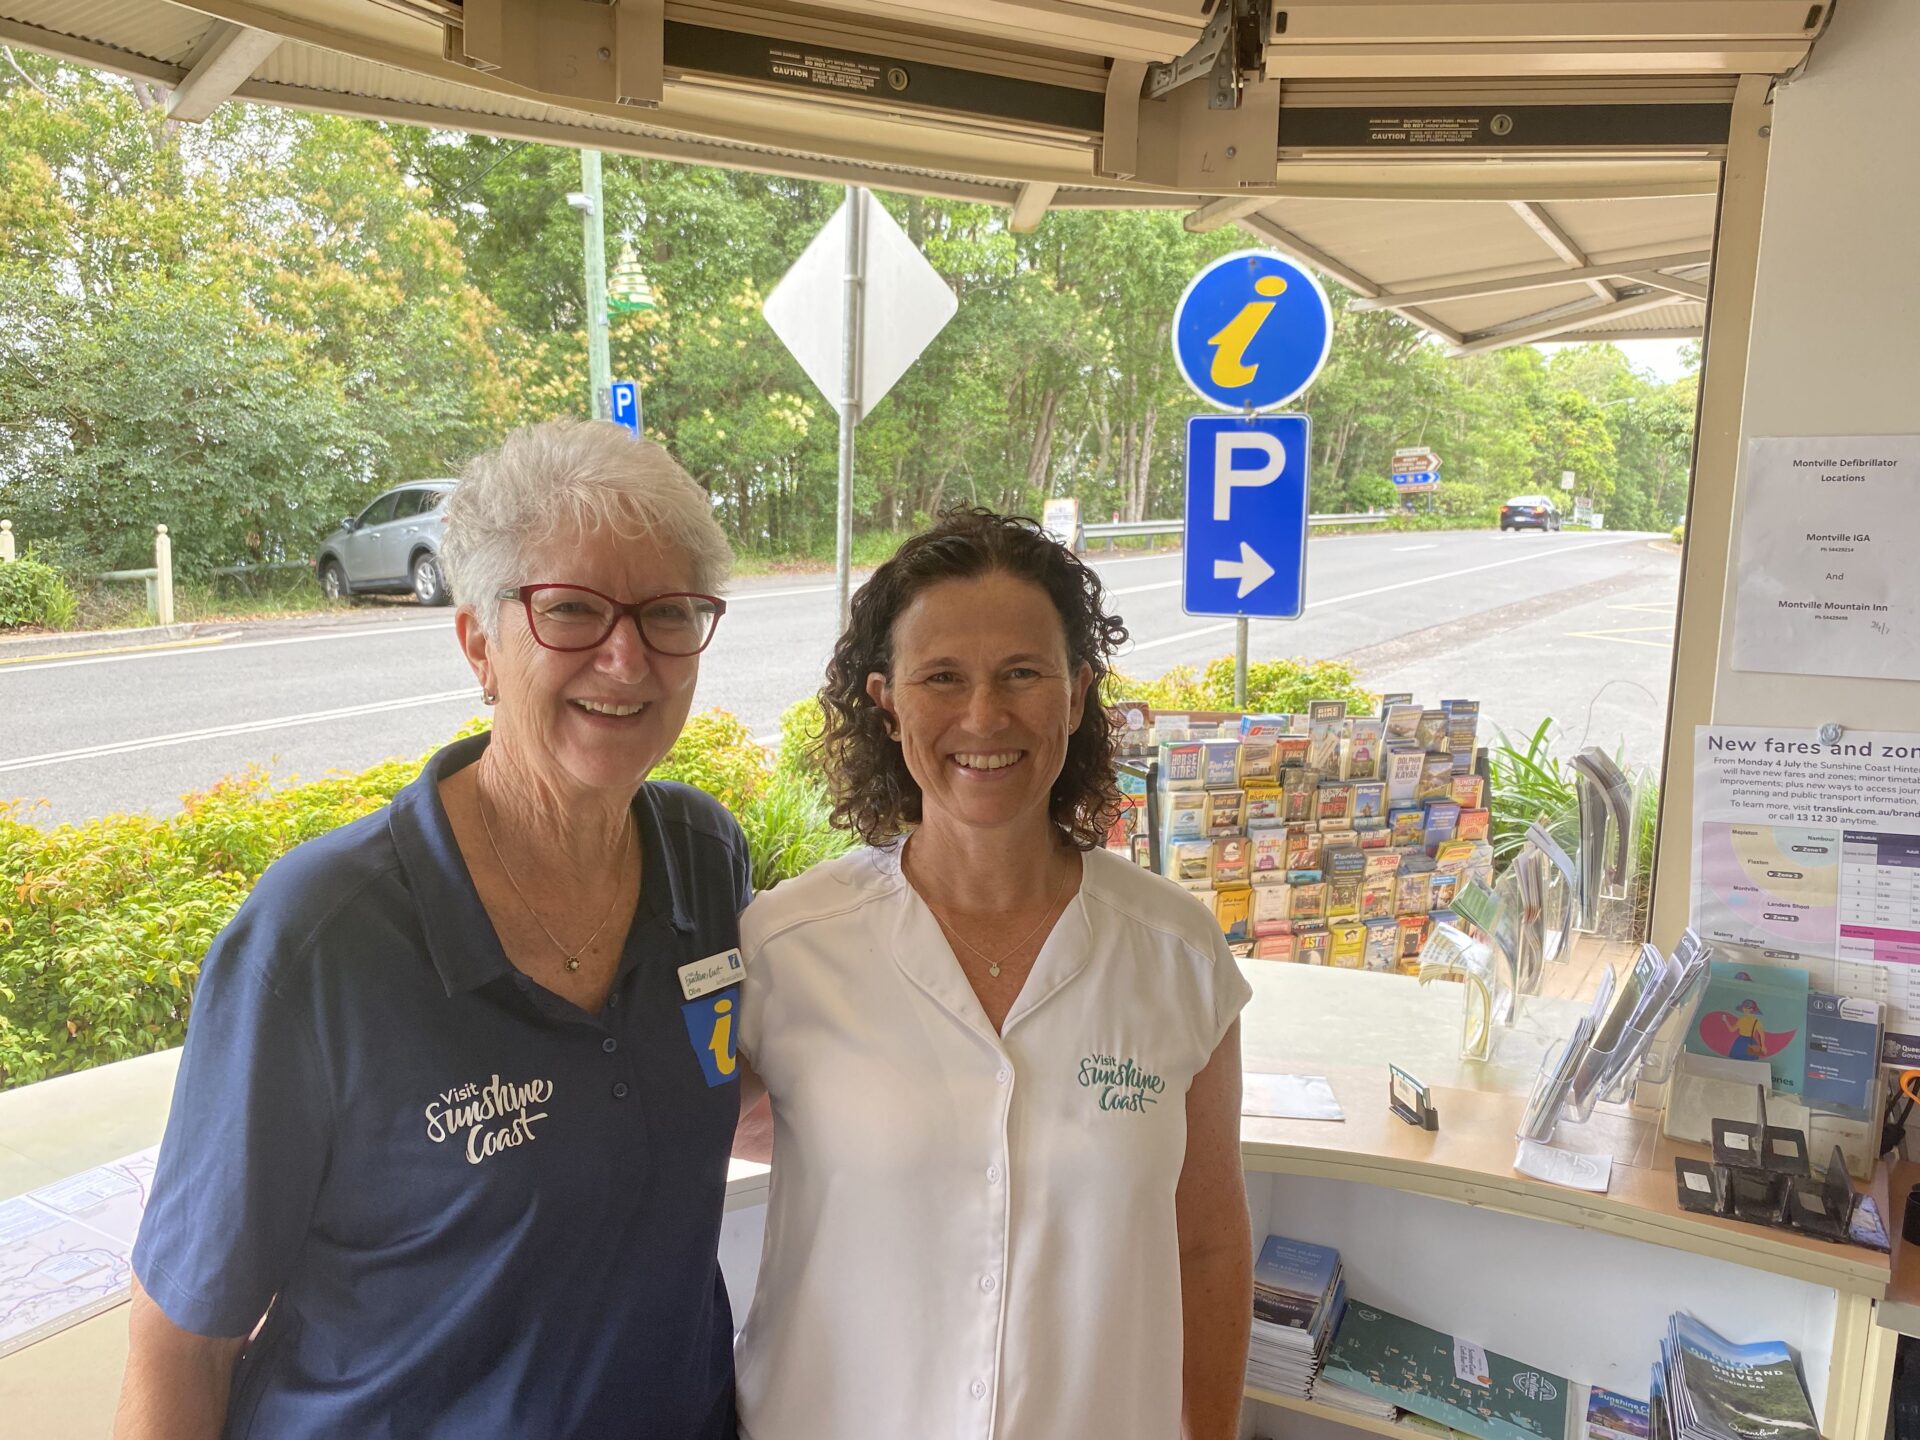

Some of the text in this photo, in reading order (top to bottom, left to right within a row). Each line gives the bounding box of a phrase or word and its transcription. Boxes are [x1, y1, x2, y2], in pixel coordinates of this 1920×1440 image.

[772, 66, 809, 78] CAUTION
[617, 387, 632, 417] P
[1792, 458, 1898, 467] Montville Defibrillator
[1213, 431, 1287, 521] P
[1821, 474, 1866, 482] Locations
[1806, 533, 1871, 542] Montville IGA
[1825, 572, 1845, 581] And
[1778, 600, 1888, 612] Montville Mountain Inn
[1708, 735, 1920, 759] New fares and zon
[1171, 753, 1198, 766] HORSE
[1713, 756, 1736, 765] From
[1737, 758, 1774, 768] Monday
[1775, 759, 1782, 767] 4
[1783, 760, 1802, 769] July
[1803, 760, 1818, 769] the
[1820, 761, 1862, 771] Sunshine
[1864, 763, 1891, 772] Coast
[1170, 766, 1196, 778] RIDES
[1394, 770, 1418, 779] KAYAK
[1739, 768, 1761, 776] have
[1783, 770, 1806, 778] fares
[1785, 780, 1804, 789] plus
[1828, 783, 1852, 791] ways
[1865, 786, 1897, 794] access
[1732, 788, 1770, 798] planning
[1790, 791, 1818, 799] public
[1819, 792, 1861, 801] transport
[1863, 795, 1919, 805] information.
[1730, 799, 1741, 807] To
[1742, 800, 1764, 808] learn
[1766, 802, 1791, 811] more,
[1813, 805, 1920, 818] translink.com.au/brand
[1779, 812, 1794, 820] call
[1796, 813, 1808, 821] 13
[1811, 814, 1823, 822] 12
[1825, 815, 1838, 823] 30
[1839, 817, 1879, 826] anytime.
[1092, 1054, 1117, 1067] Visit
[1078, 1058, 1165, 1094] Sunshine
[440, 1082, 479, 1105] Visit
[1098, 1086, 1157, 1113] Coast
[425, 1074, 553, 1143] Sunshine
[465, 1107, 548, 1165] Coast
[1690, 1347, 1784, 1376] QUEENSLAND
[1712, 1365, 1764, 1383] DRIVES
[1714, 1374, 1747, 1388] TOURING
[1597, 1391, 1639, 1411] Sunshine
[1728, 1422, 1779, 1437] Queensland
